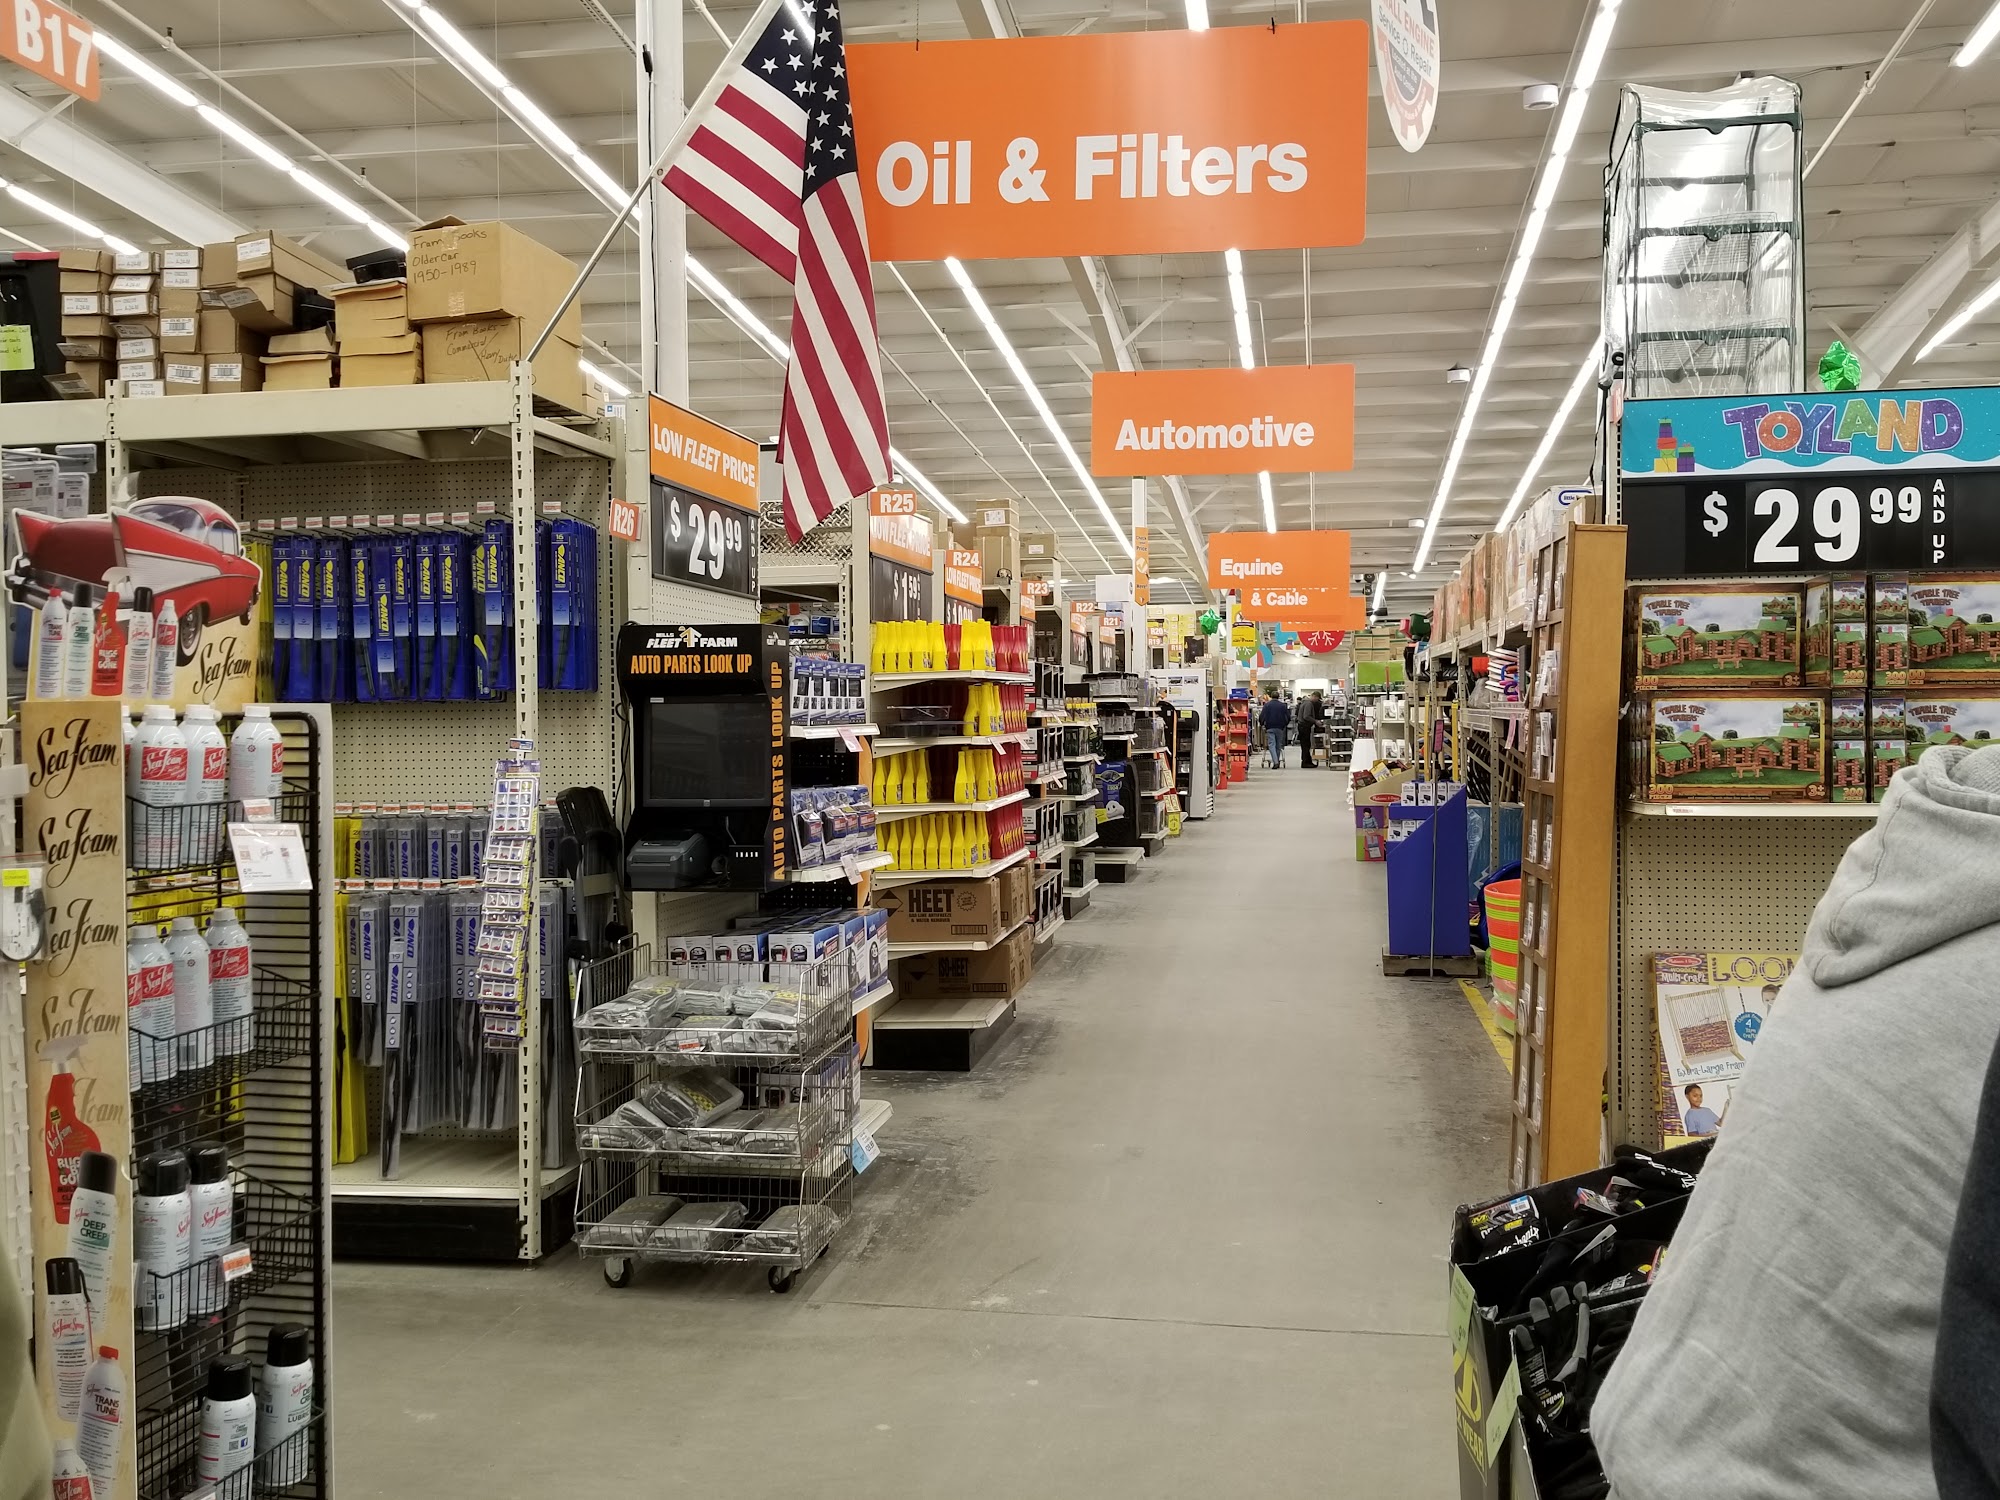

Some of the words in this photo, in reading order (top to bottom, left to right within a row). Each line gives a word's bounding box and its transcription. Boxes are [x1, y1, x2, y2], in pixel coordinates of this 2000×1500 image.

[15, 0, 92, 87] B17
[1379, 5, 1401, 45] Service
[1410, 43, 1432, 77] Repair
[1404, 10, 1435, 58] ENGINE
[876, 139, 972, 207] Oil
[998, 136, 1051, 204] &
[1074, 132, 1308, 201] Filters
[413, 260, 477, 284] 1950-1989
[1115, 415, 1315, 451] Automotive
[1722, 398, 1964, 459] TOYLAND
[653, 423, 683, 459] LOW
[683, 437, 721, 473] FLEET
[722, 452, 756, 488] PRICE
[880, 493, 914, 513] R25
[1932, 479, 1946, 524] AND
[612, 503, 634, 537] R26
[1702, 490, 1729, 537] $
[1753, 486, 1861, 563] 29
[1869, 487, 1922, 524] 99
[670, 497, 681, 542] $
[688, 503, 725, 580] 29
[725, 517, 742, 552] 99
[872, 515, 889, 543] LOW
[889, 521, 906, 548] FLEET
[906, 528, 931, 557] PRICE
[1932, 534, 1946, 564] UP
[489, 554, 498, 584] ANCO
[557, 554, 566, 584] ANCO
[953, 551, 979, 567] R24
[1220, 558, 1284, 579] Equine
[279, 569, 289, 598] ANCO
[301, 569, 311, 598] ANCO
[325, 569, 334, 599] ANCO
[357, 569, 366, 598] ANCO
[396, 567, 405, 596] ANCO
[422, 566, 431, 595] ANCO
[444, 565, 453, 594] ANCO
[894, 569, 899, 601] $
[908, 575, 918, 600] 59
[946, 566, 956, 585] LOW
[956, 570, 969, 590] FLEET
[1027, 582, 1049, 595] R23
[1076, 602, 1095, 613] R22
[1250, 592, 1262, 607] &
[1266, 591, 1308, 606] Cable
[1674, 599, 1691, 610] TREE
[1942, 588, 1960, 599] TREE
[381, 604, 390, 632] ANCO
[1103, 617, 1119, 626] R21
[646, 638, 682, 648] FLEET
[700, 637, 738, 648] FARM
[631, 655, 660, 674] AUTO
[664, 654, 701, 674] PARTS
[704, 654, 734, 673] LOOK
[736, 654, 752, 673] UP
[771, 661, 784, 689] UP
[1843, 669, 1864, 679] 300
[1885, 671, 1906, 680] 300
[1909, 669, 1925, 680] 00
[1636, 675, 1659, 686] 300
[771, 695, 784, 748] LOOK
[1688, 705, 1706, 716] TREE
[1939, 705, 1958, 716] TREE
[30, 727, 67, 787] Sea
[44, 718, 119, 799] Foam
[772, 754, 785, 822] PARTS
[1649, 784, 1674, 795] 300
[1843, 787, 1864, 796] 300
[46, 808, 119, 889] Foam
[773, 826, 786, 881] AUTO
[401, 850, 409, 878] ANCO
[431, 850, 439, 878] ANCO
[909, 888, 955, 913] HEET
[45, 898, 121, 978] Foam
[363, 933, 372, 961] ANCO
[406, 932, 415, 959] ANCO
[455, 931, 464, 956] ANCO
[468, 930, 477, 957] ANCO
[390, 977, 399, 1005] ANCO
[1745, 1018, 1752, 1028] 4
[1676, 1064, 1725, 1078] Extra-Large
[80, 1228, 108, 1240] CREEP
[83, 1218, 107, 1229] DEEP
[94, 1394, 120, 1407] TRANS
[96, 1404, 118, 1416] TUNE
[1462, 1421, 1485, 1470] WEAR
